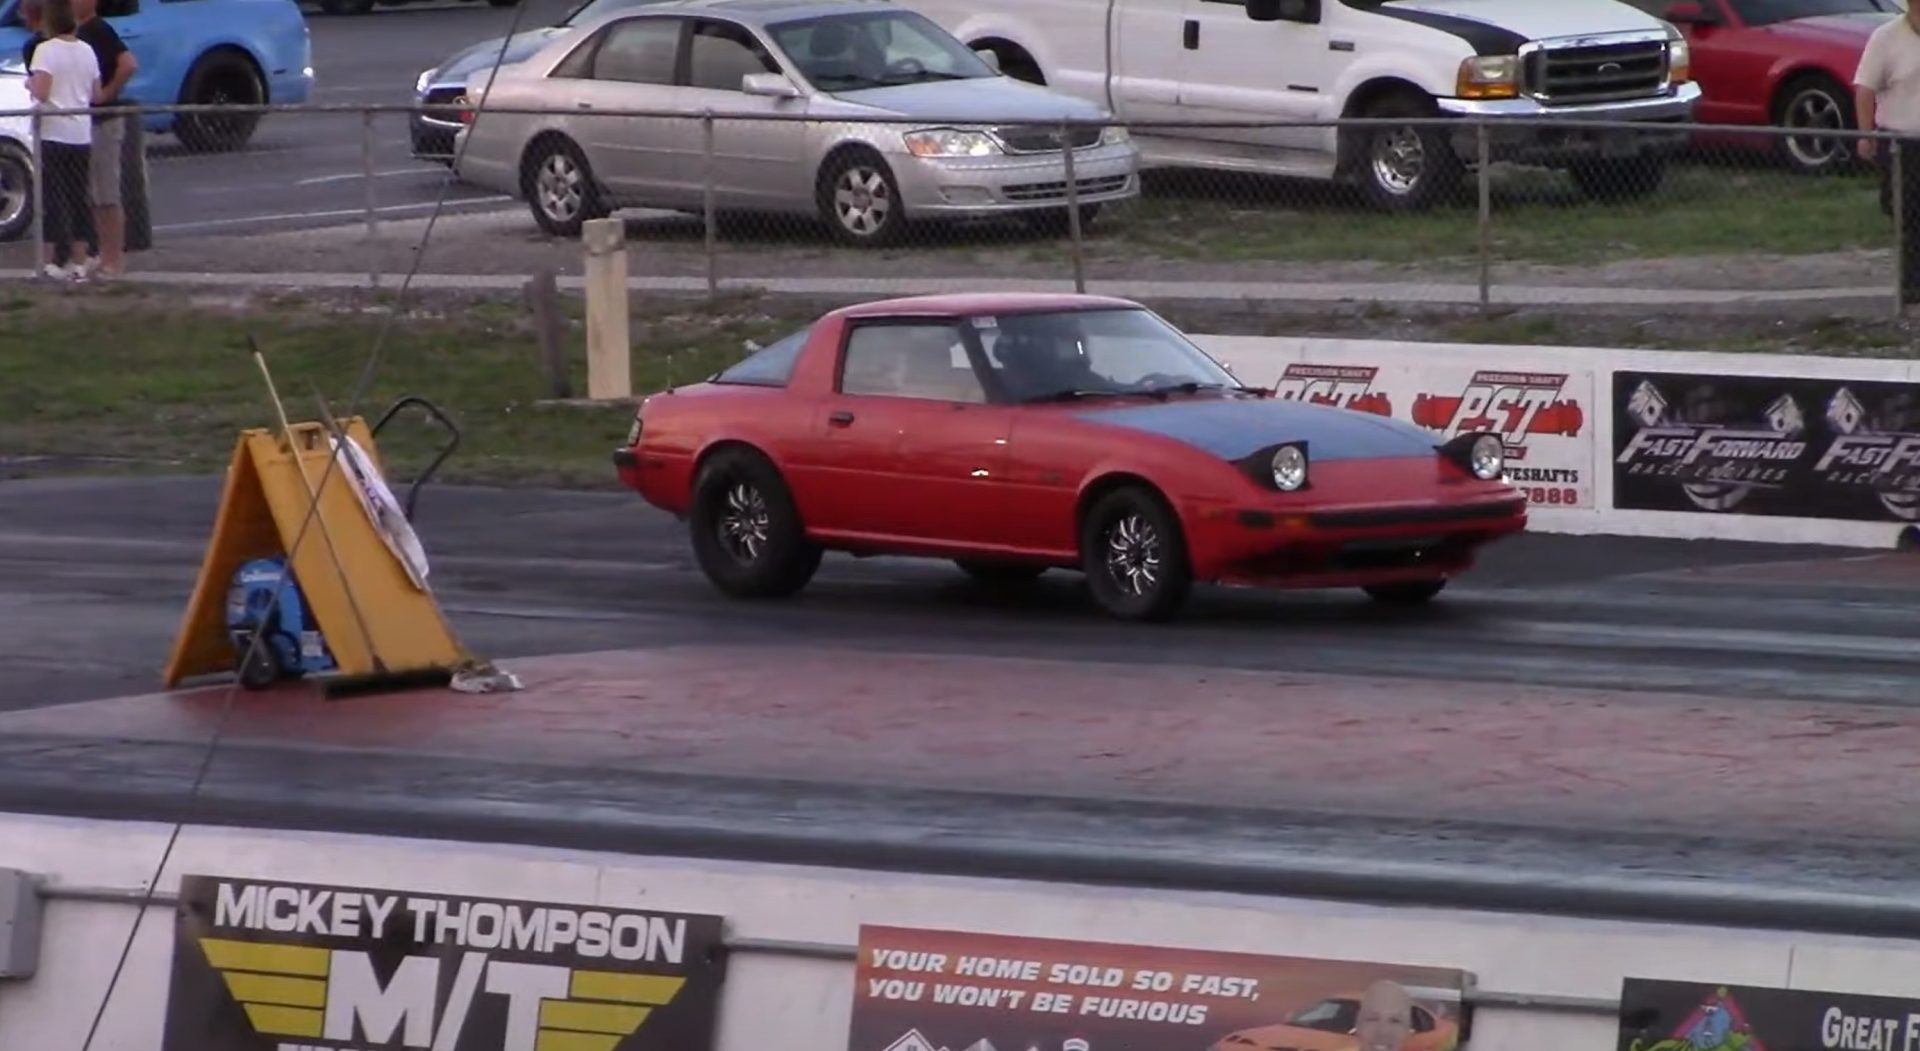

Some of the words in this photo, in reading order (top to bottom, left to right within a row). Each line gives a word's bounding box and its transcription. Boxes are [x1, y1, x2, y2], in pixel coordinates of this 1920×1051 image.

[1446, 385, 1560, 444] PST
[1616, 427, 1696, 463] FAST
[1681, 430, 1807, 464] FORWARD
[1814, 436, 1893, 471] FAST
[1503, 467, 1578, 483] VESHAFTS
[214, 883, 397, 938] MICKEY
[406, 898, 686, 964] THOMPSON
[872, 949, 947, 973] YOUR
[955, 956, 1042, 981] HOME
[1048, 963, 1124, 987] SOLD
[1132, 970, 1173, 992] SO
[1181, 974, 1260, 1001] FAST,
[323, 949, 571, 1051] M/T
[868, 978, 925, 1001] YOU
[933, 984, 1026, 1010] WON'T
[1030, 992, 1073, 1014] BE
[1080, 996, 1208, 1025] FURIOUS
[1821, 1006, 1899, 1051] GREAT
